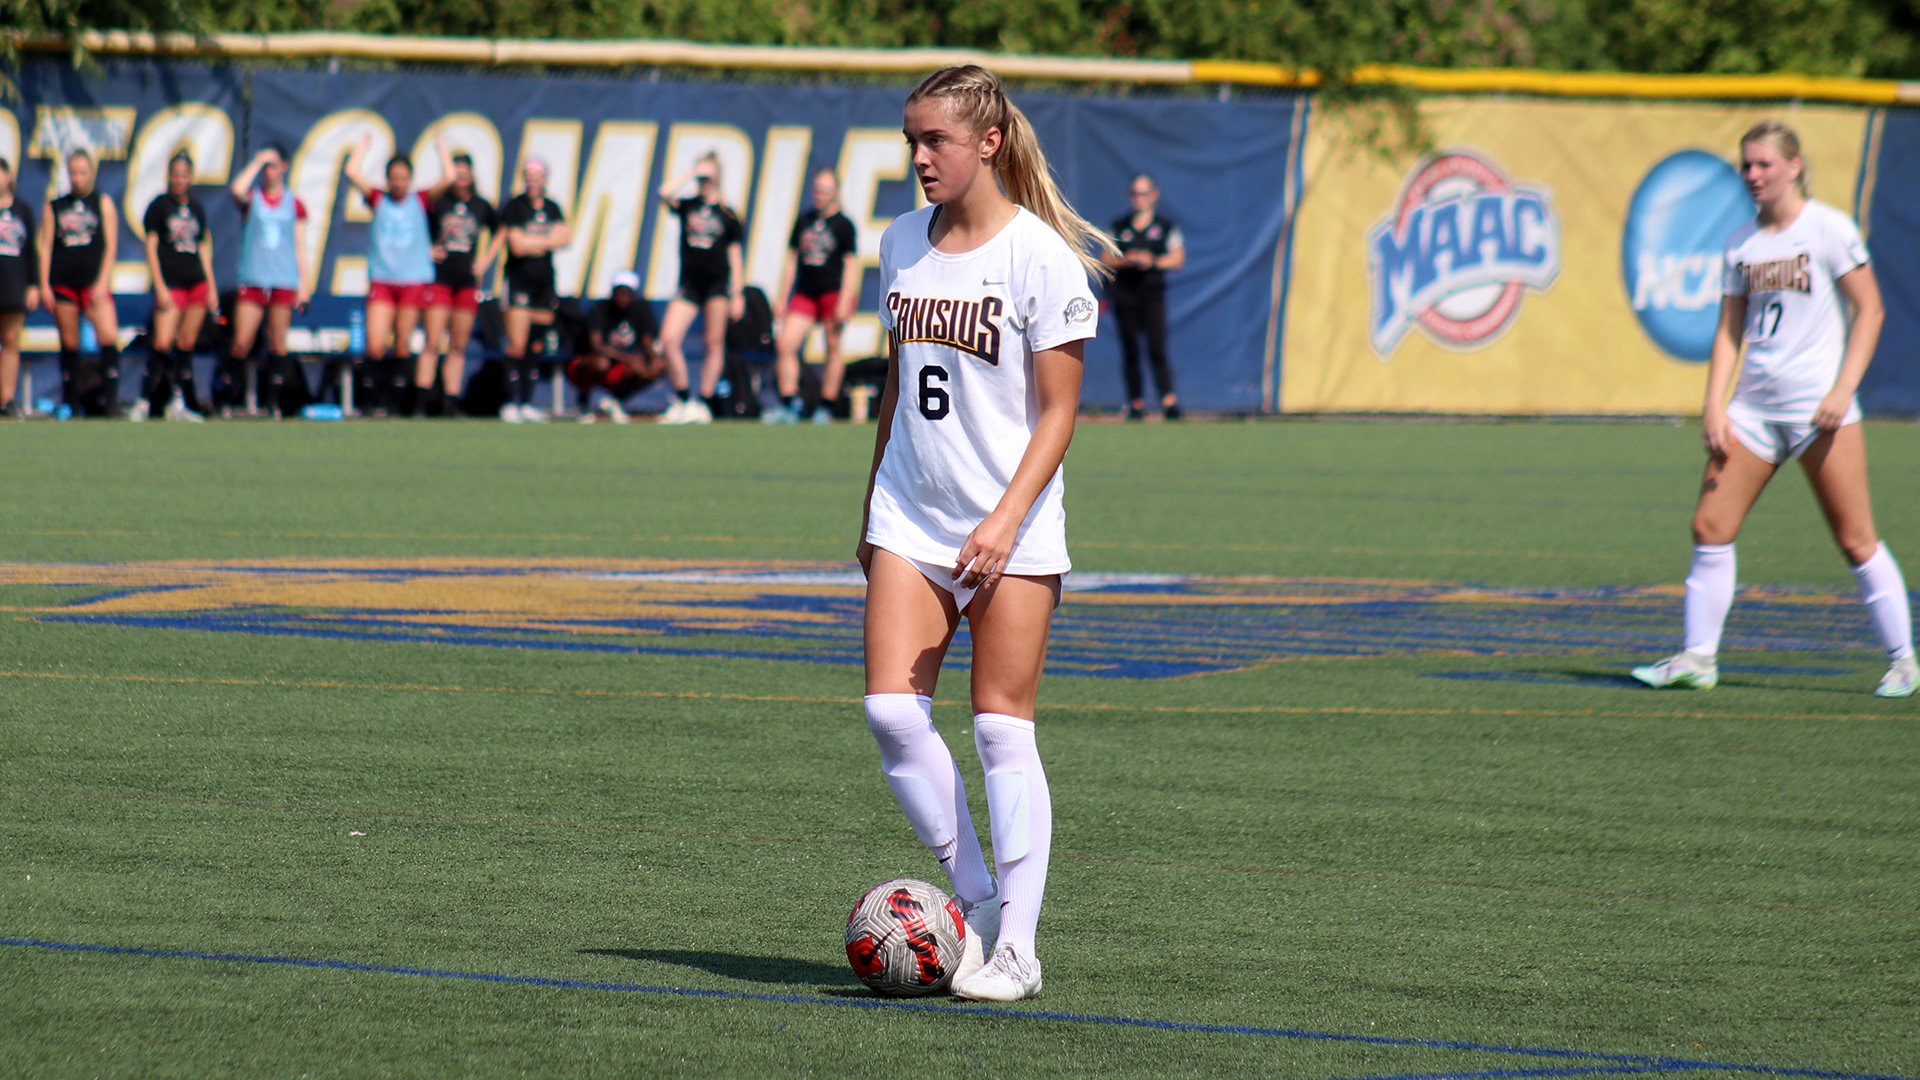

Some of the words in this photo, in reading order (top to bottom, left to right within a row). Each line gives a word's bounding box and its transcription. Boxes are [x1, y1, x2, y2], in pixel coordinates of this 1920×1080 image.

[0, 103, 235, 352] TS
[284, 108, 930, 363] COMPLE
[1376, 194, 1548, 334] MAAC
[1633, 253, 1723, 311] NCA
[1063, 300, 1094, 326] MAAC
[1758, 301, 1784, 338] 17
[918, 365, 950, 421] 6
